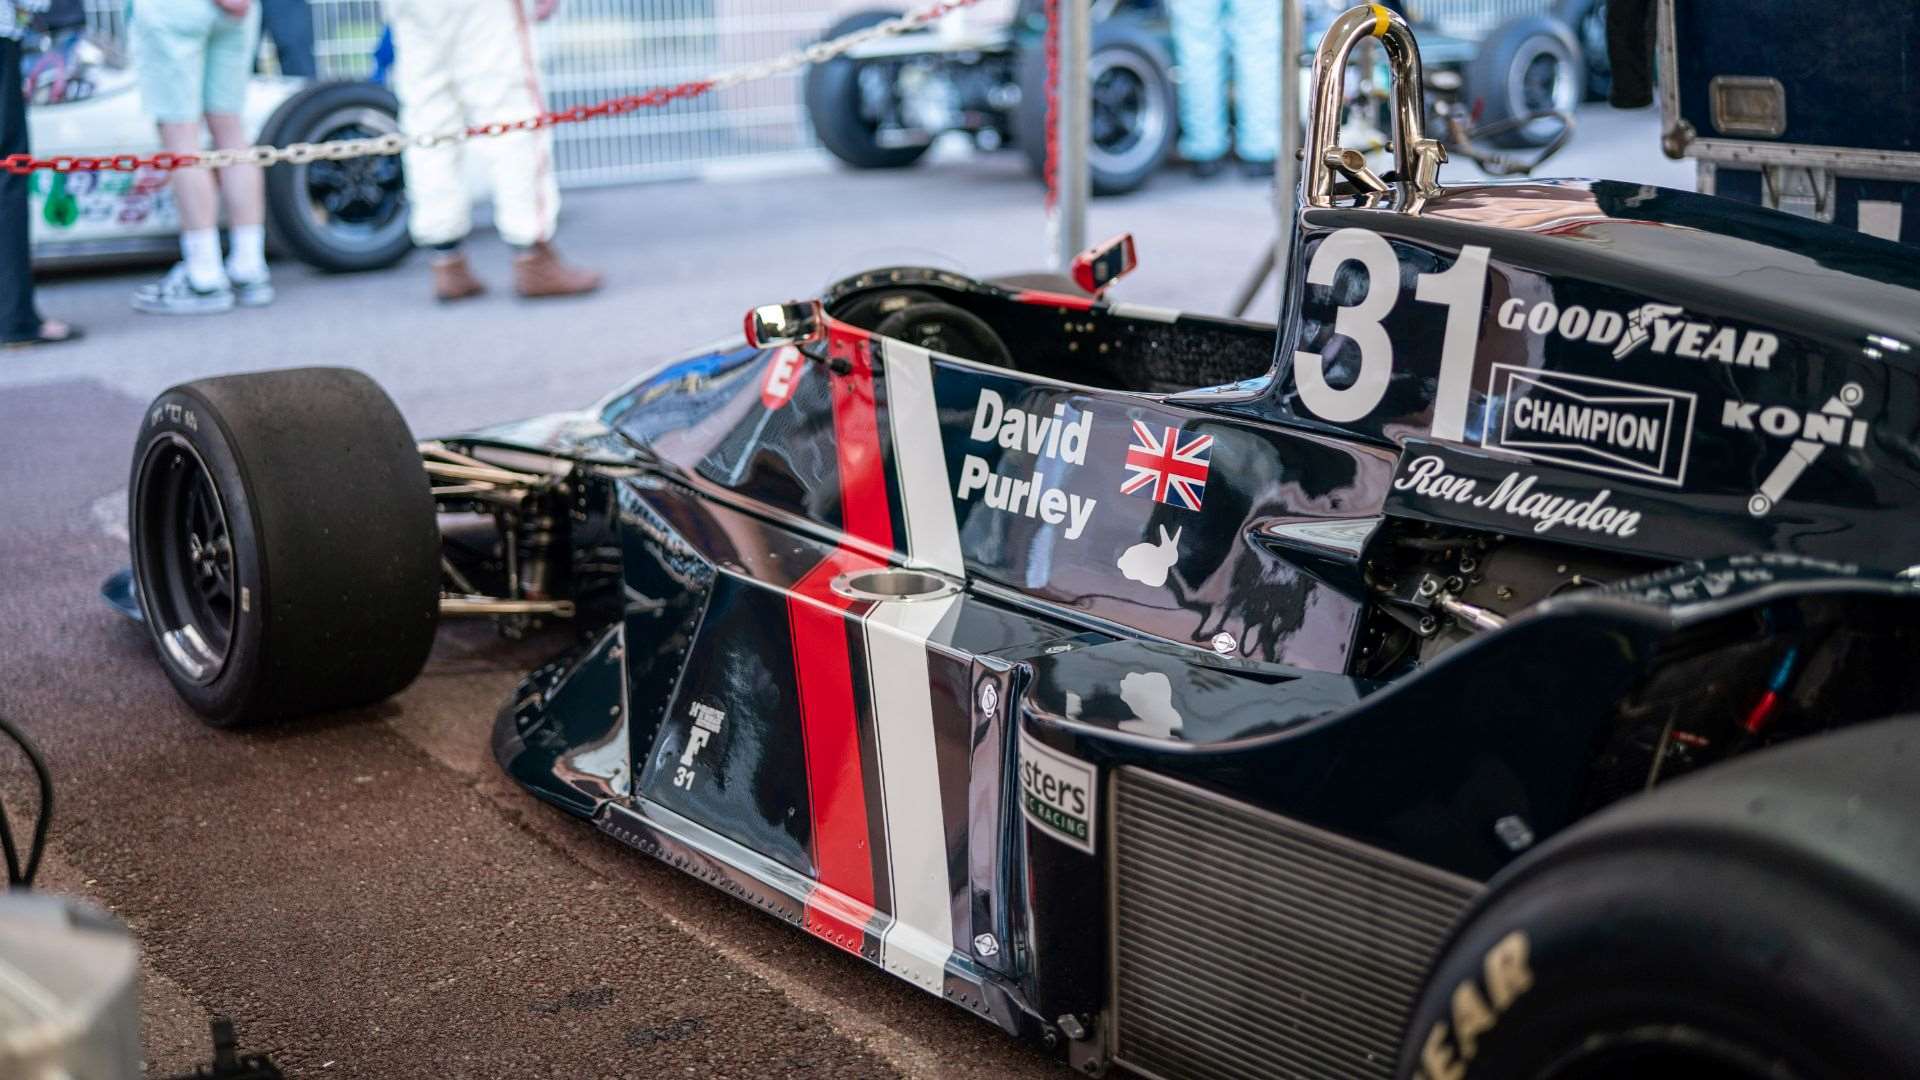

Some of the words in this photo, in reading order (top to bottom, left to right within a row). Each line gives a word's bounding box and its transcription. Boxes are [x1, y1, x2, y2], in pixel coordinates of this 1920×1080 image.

[1293, 228, 1491, 443] 31
[767, 346, 799, 398] E
[970, 388, 1094, 466] David
[1513, 396, 1662, 452] CHAMPION
[1721, 400, 1868, 449] KONI
[957, 454, 1097, 540] Purley
[1394, 455, 1475, 503] Ron
[1472, 472, 1642, 537] Maydon
[673, 766, 696, 791] 31
[1019, 759, 1085, 815] sters
[1037, 801, 1086, 837] RACING
[1411, 929, 1536, 1080] EAR
